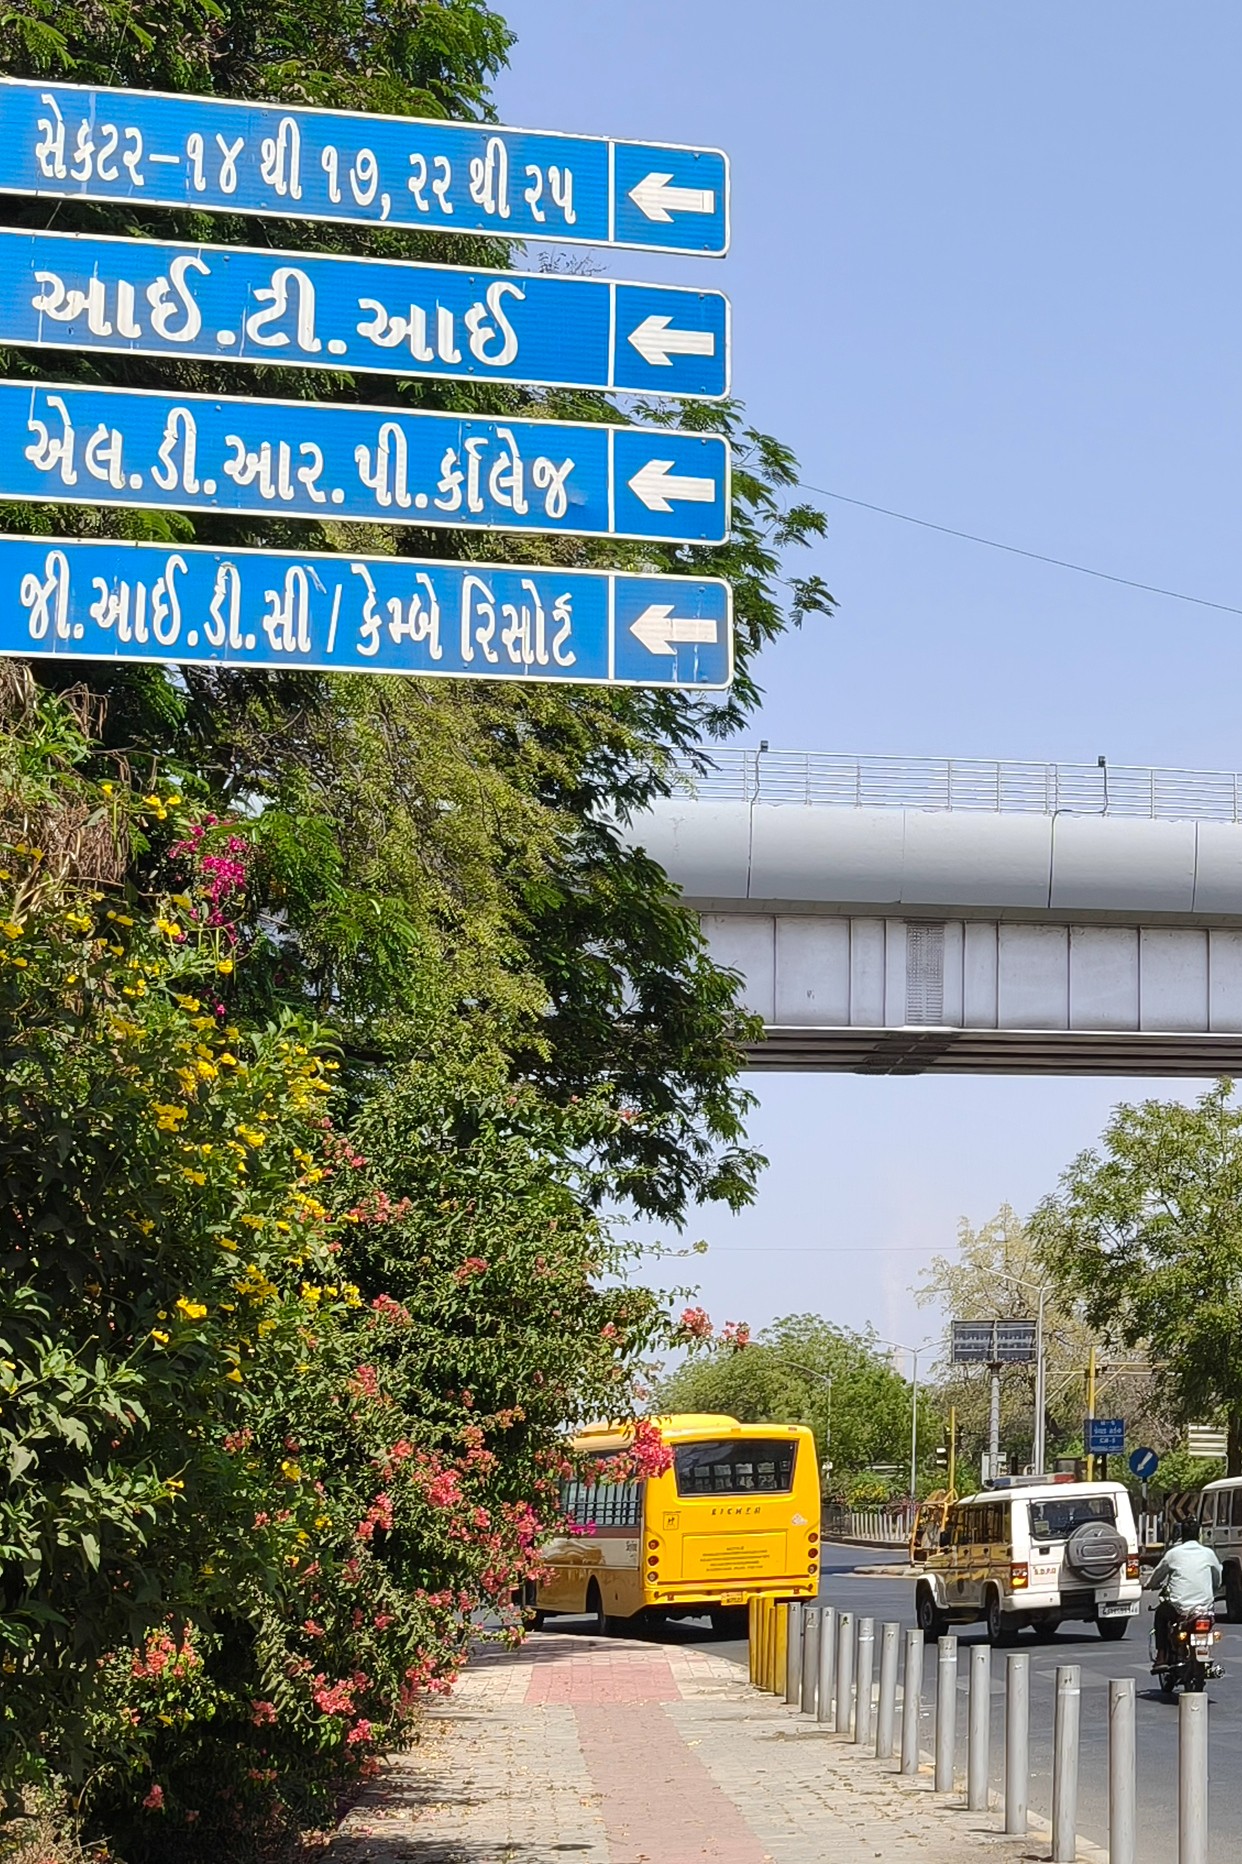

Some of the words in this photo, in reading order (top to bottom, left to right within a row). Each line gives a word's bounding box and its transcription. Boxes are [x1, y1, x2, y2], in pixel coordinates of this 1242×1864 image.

[260, 116, 302, 200] થી
[407, 152, 454, 215] ૨૨
[469, 136, 511, 219] થી
[524, 163, 577, 225] ૨૫
[711, 1506, 761, 1516] EICHER
